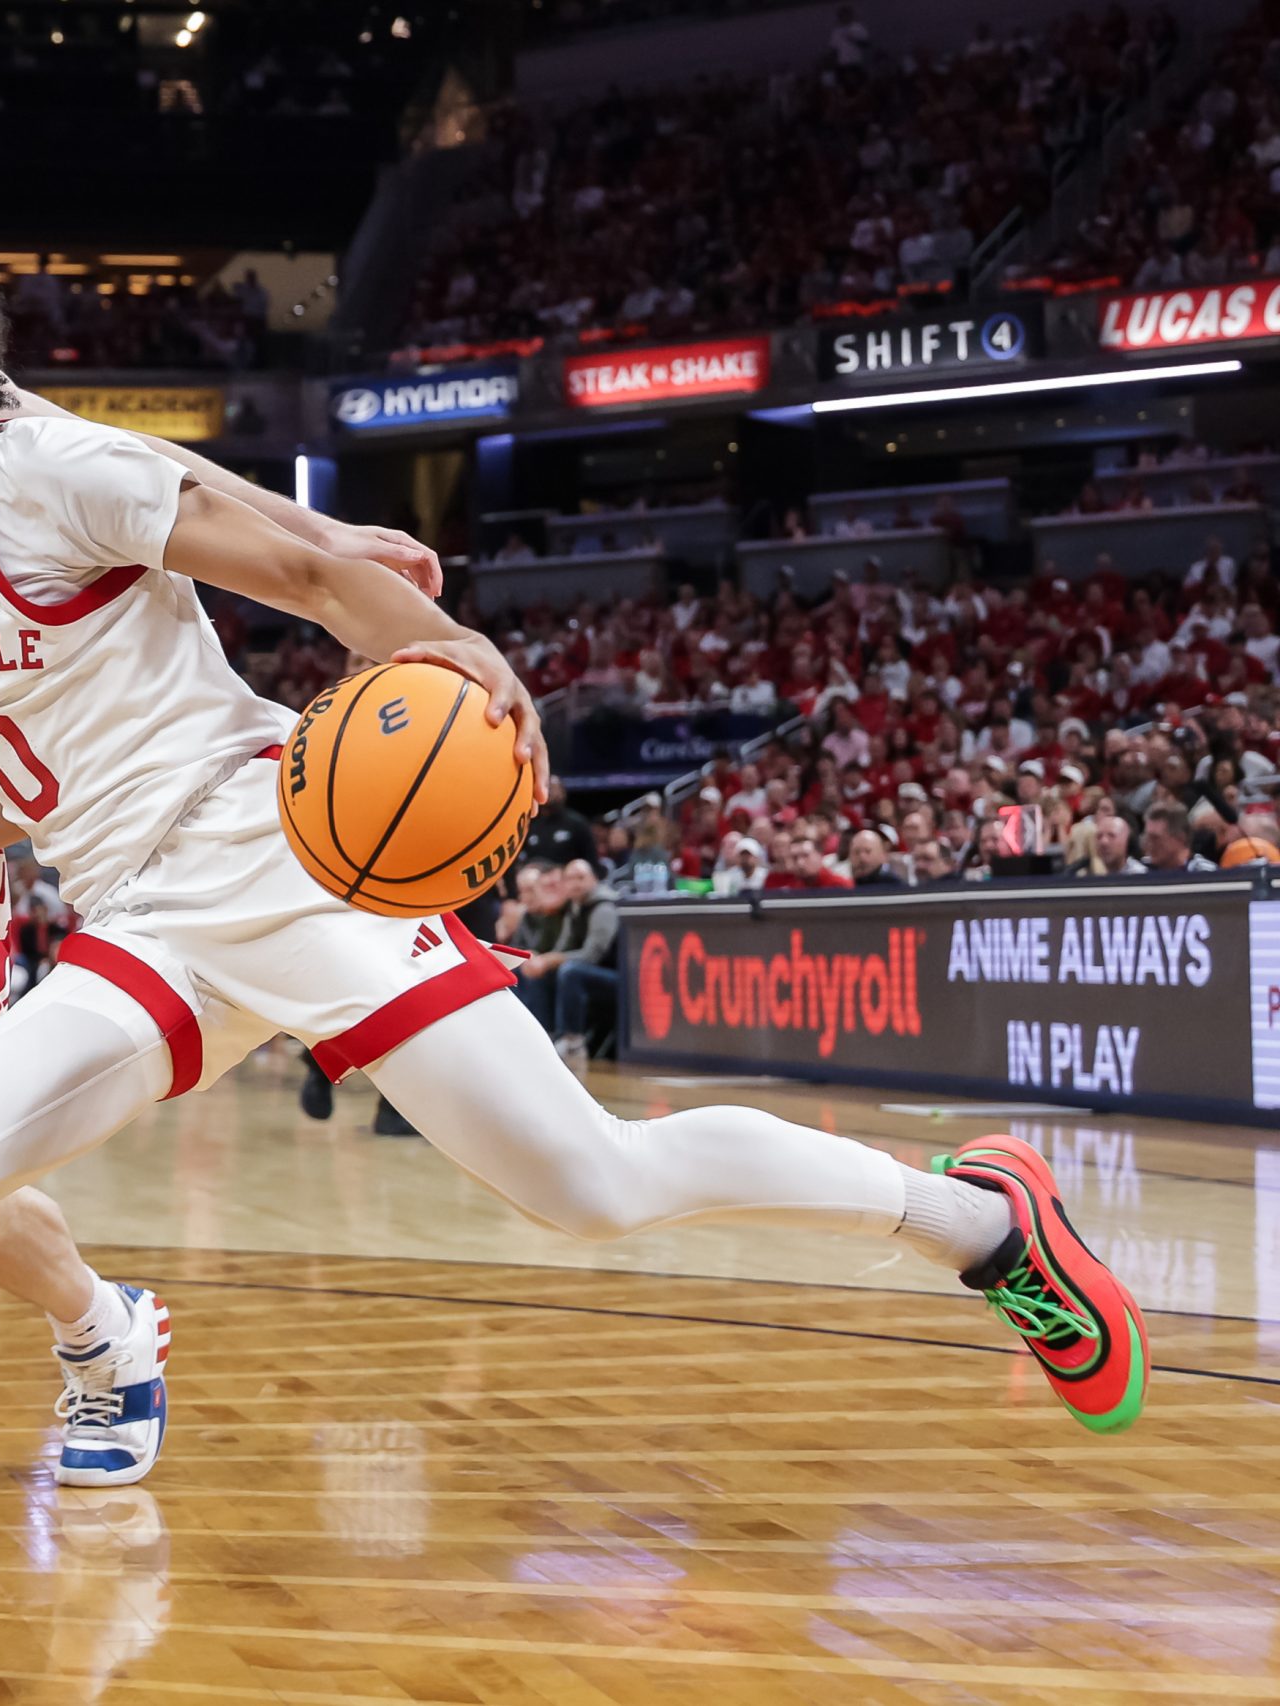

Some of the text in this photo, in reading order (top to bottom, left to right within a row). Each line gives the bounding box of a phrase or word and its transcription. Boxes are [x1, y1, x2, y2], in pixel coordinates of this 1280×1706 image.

[1100, 285, 1256, 346] LUCAS
[569, 362, 651, 396] STEAK
[671, 351, 759, 385] SHAKE
[834, 320, 1012, 373] SHIFT 4
[384, 376, 518, 416] HYUNDAI
[947, 914, 1212, 987] ANIME ALWAYS
[678, 927, 922, 1058] Crunchyroll
[1007, 1020, 1140, 1095] IN PLAY
